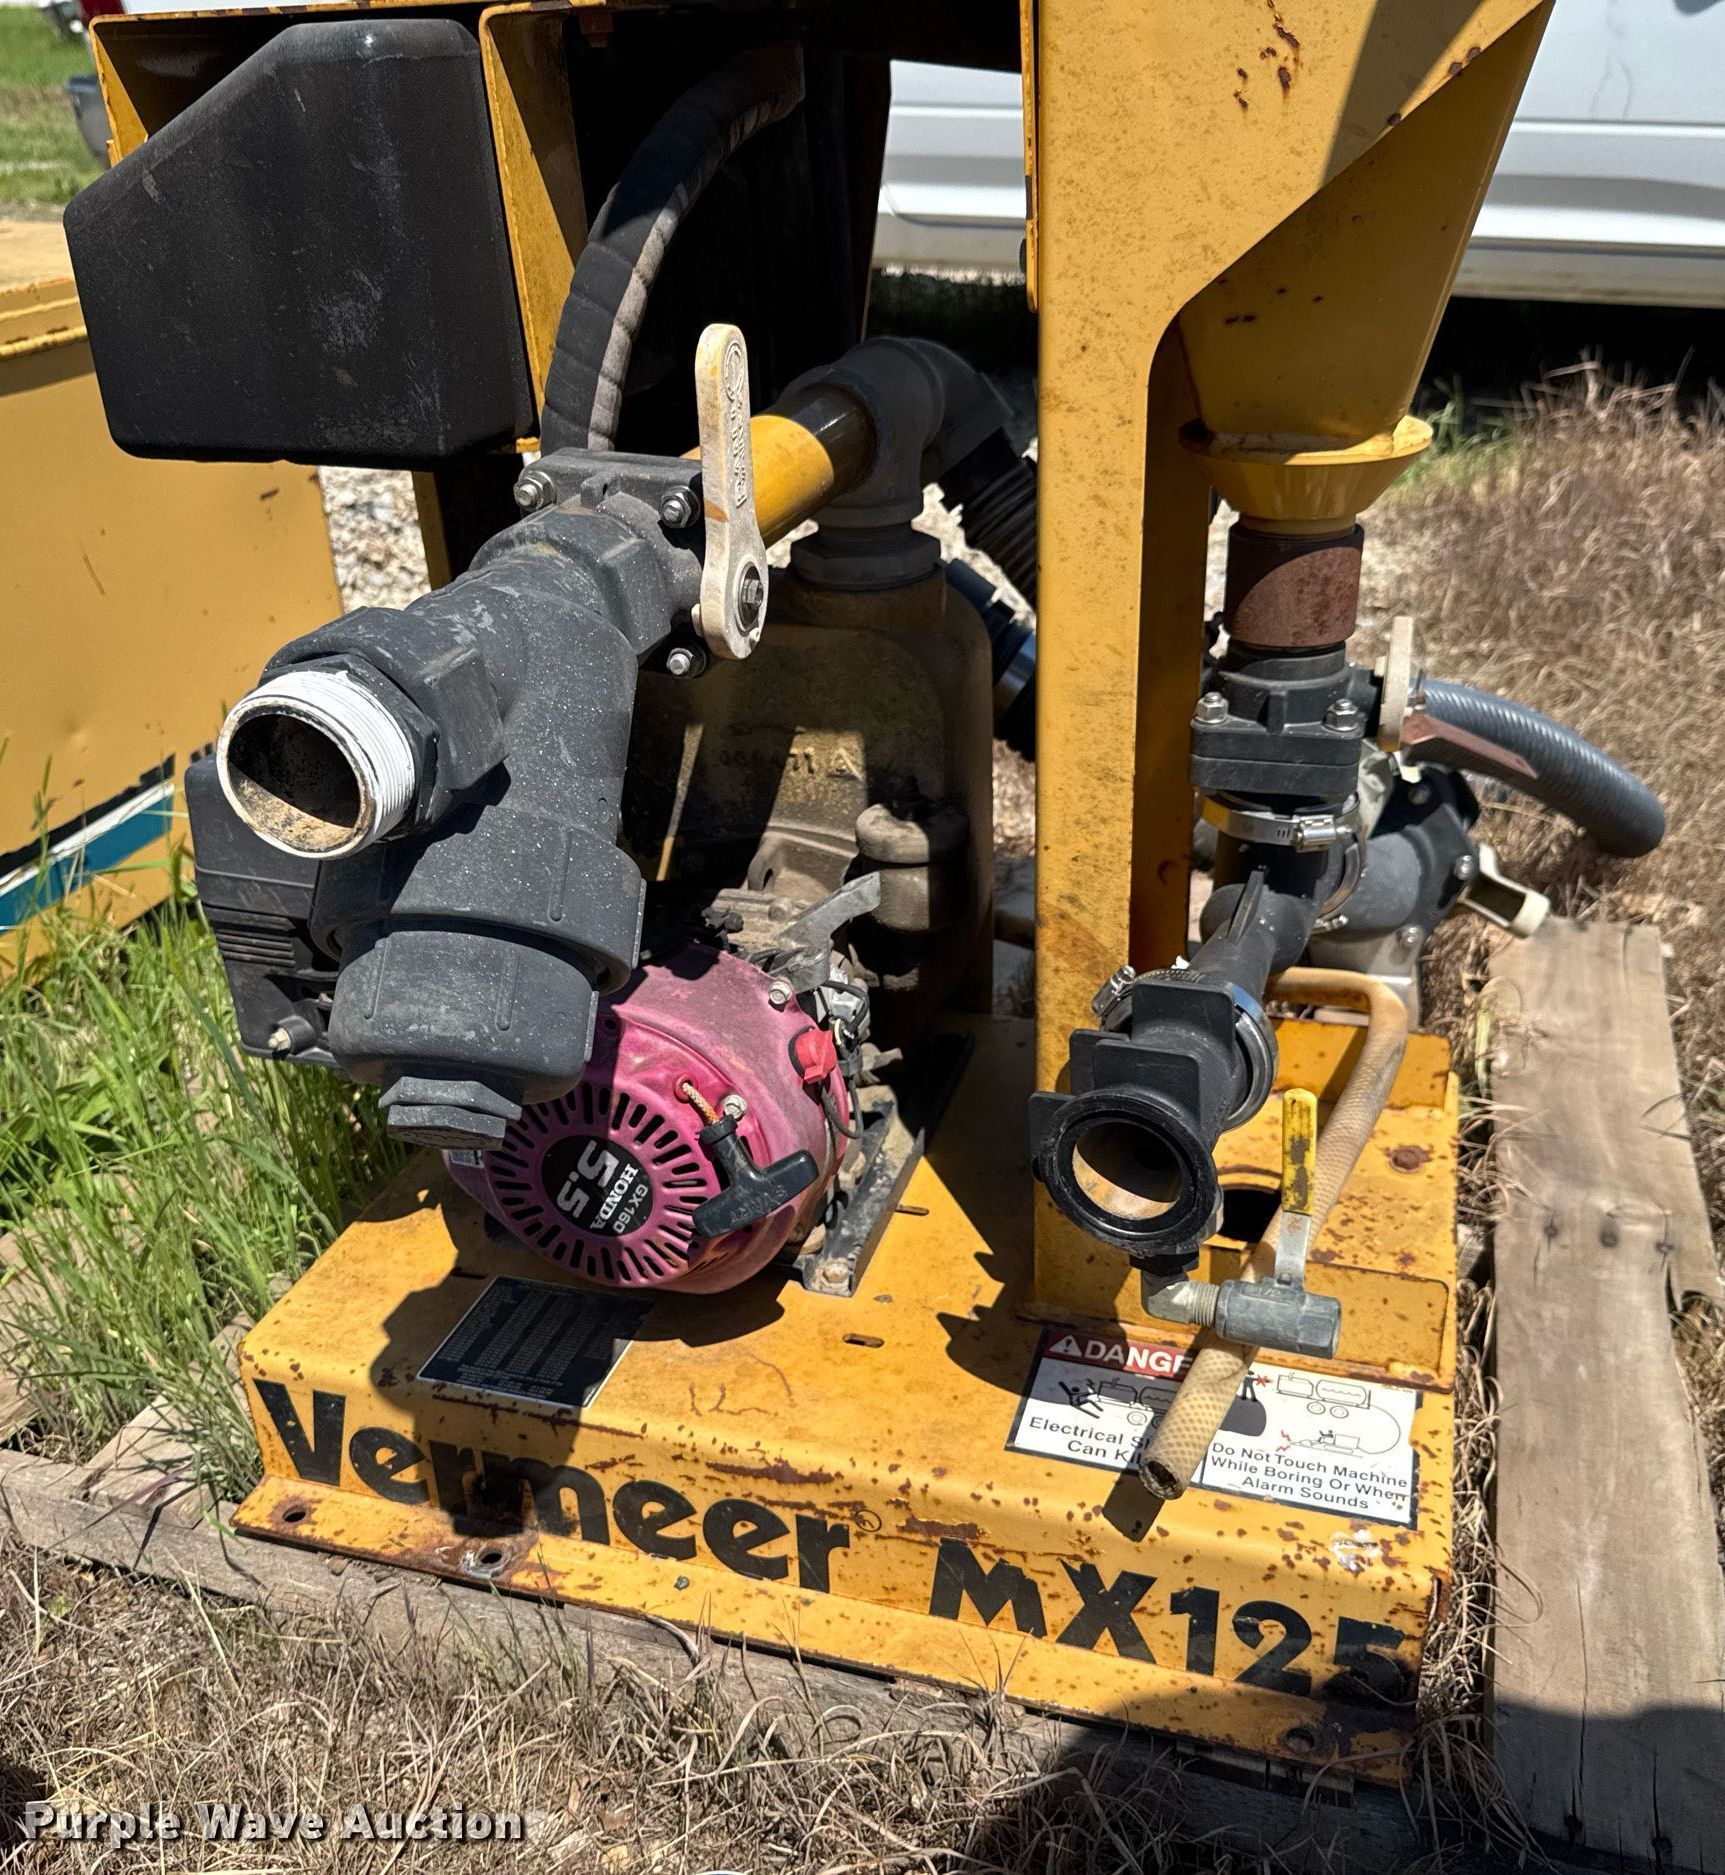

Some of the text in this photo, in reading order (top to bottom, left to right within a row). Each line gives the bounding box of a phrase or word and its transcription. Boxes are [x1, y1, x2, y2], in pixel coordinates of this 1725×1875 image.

[556, 1139, 619, 1218] 5.5
[589, 1163, 639, 1229] HONDA
[612, 1184, 649, 1233] GX160
[1084, 1340, 1193, 1374] DANGE
[1029, 1416, 1124, 1445] Electrical
[1067, 1439, 1107, 1458] Can
[1211, 1455, 1406, 1502] While Boring Or When
[1212, 1442, 1408, 1488] Do Not Touch Machine
[1242, 1475, 1369, 1509] Alarm Sounds
[253, 1377, 1413, 1701] Vermeer MX125
